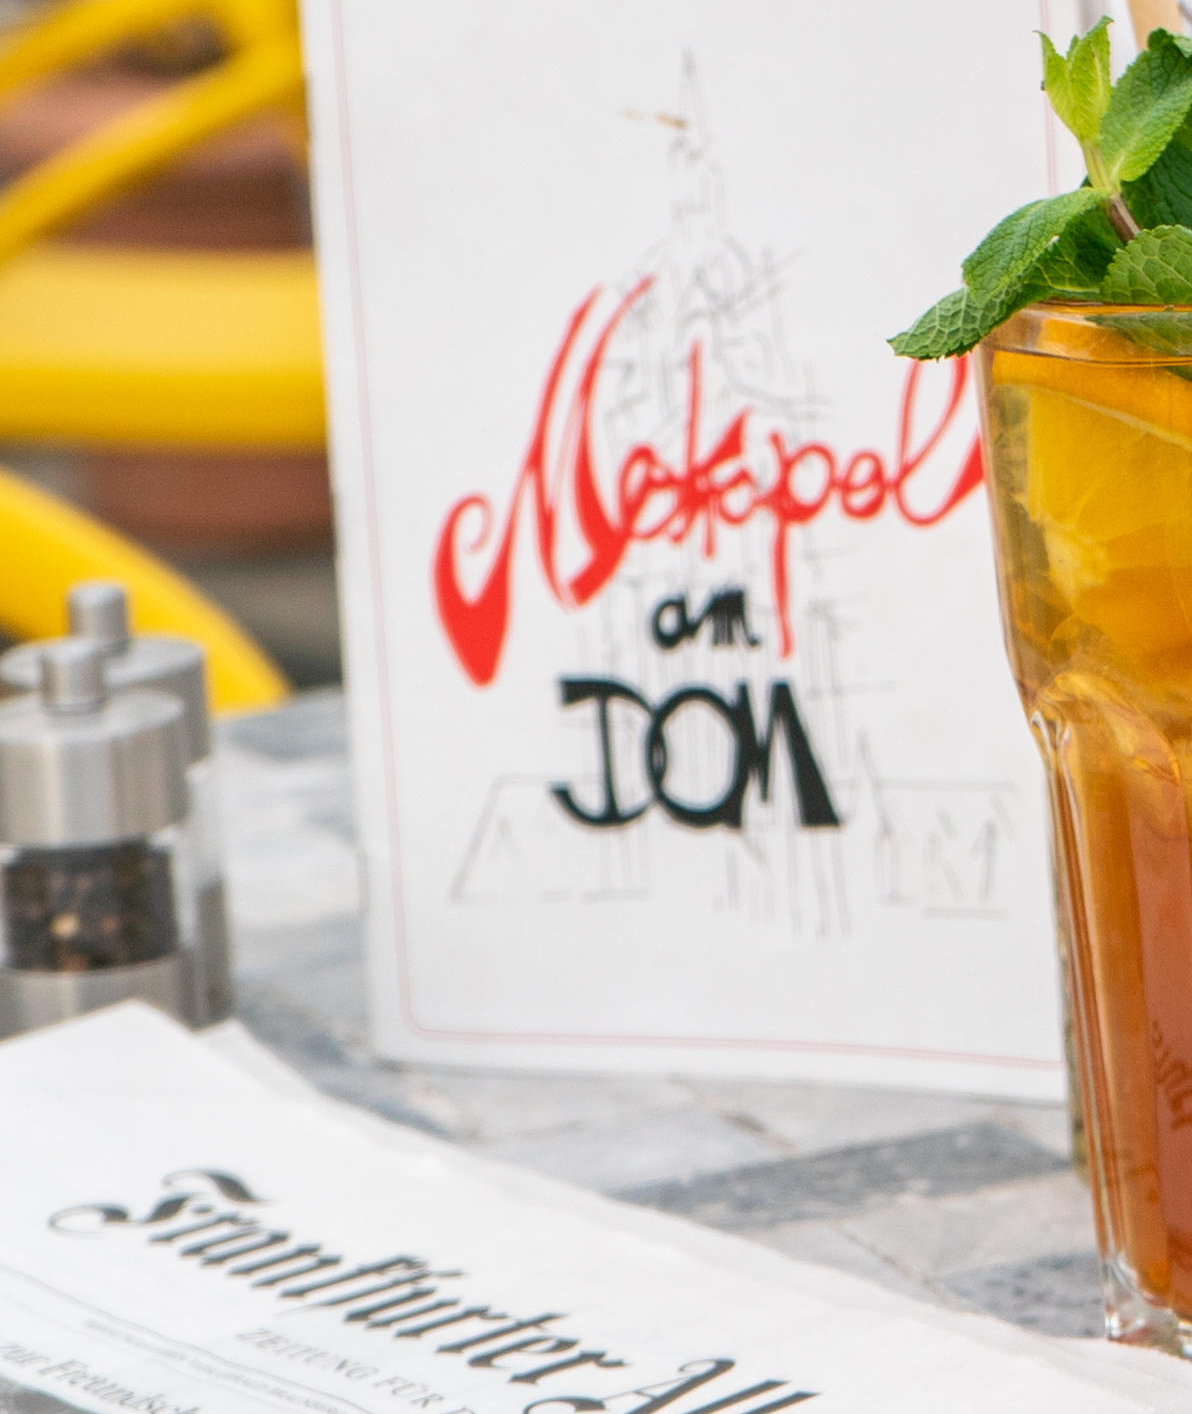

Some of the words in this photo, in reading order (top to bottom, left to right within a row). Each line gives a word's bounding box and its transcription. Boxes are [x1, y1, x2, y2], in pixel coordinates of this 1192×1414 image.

[651, 583, 759, 650] am
[547, 673, 842, 829] DOM
[48, 1169, 632, 1384] Frankfurter
[235, 1328, 379, 1380] ZEITUNG
[373, 1372, 447, 1410] FÜR
